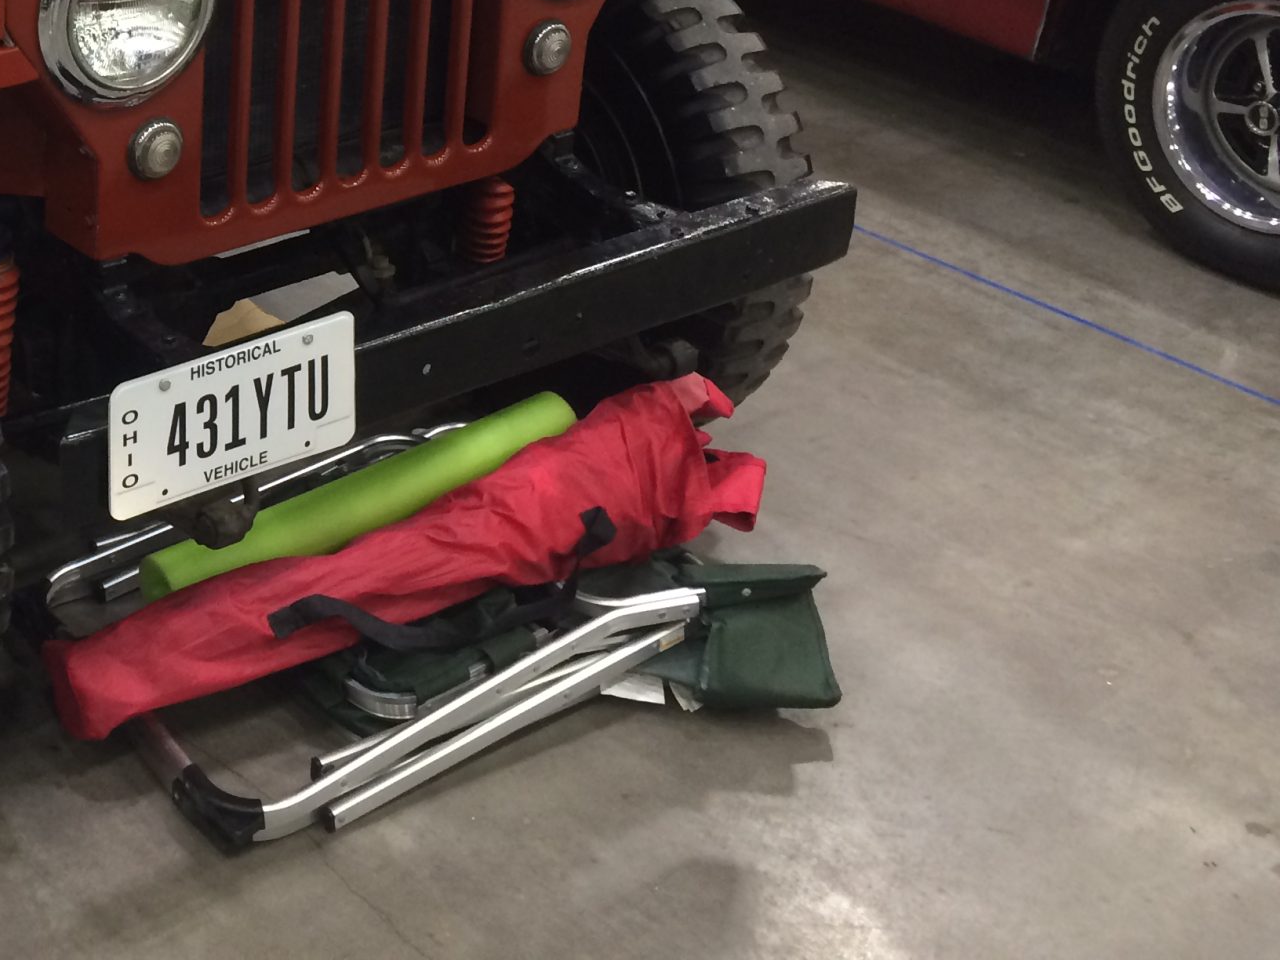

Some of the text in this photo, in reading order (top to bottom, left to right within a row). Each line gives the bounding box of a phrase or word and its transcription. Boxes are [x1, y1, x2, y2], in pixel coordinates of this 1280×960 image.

[1120, 16, 1184, 214] BFGoodrich
[190, 340, 281, 381] HISTORICAL
[121, 409, 139, 489] OHIO
[166, 354, 329, 468] 431YTU
[204, 450, 269, 483] VEHICLE
